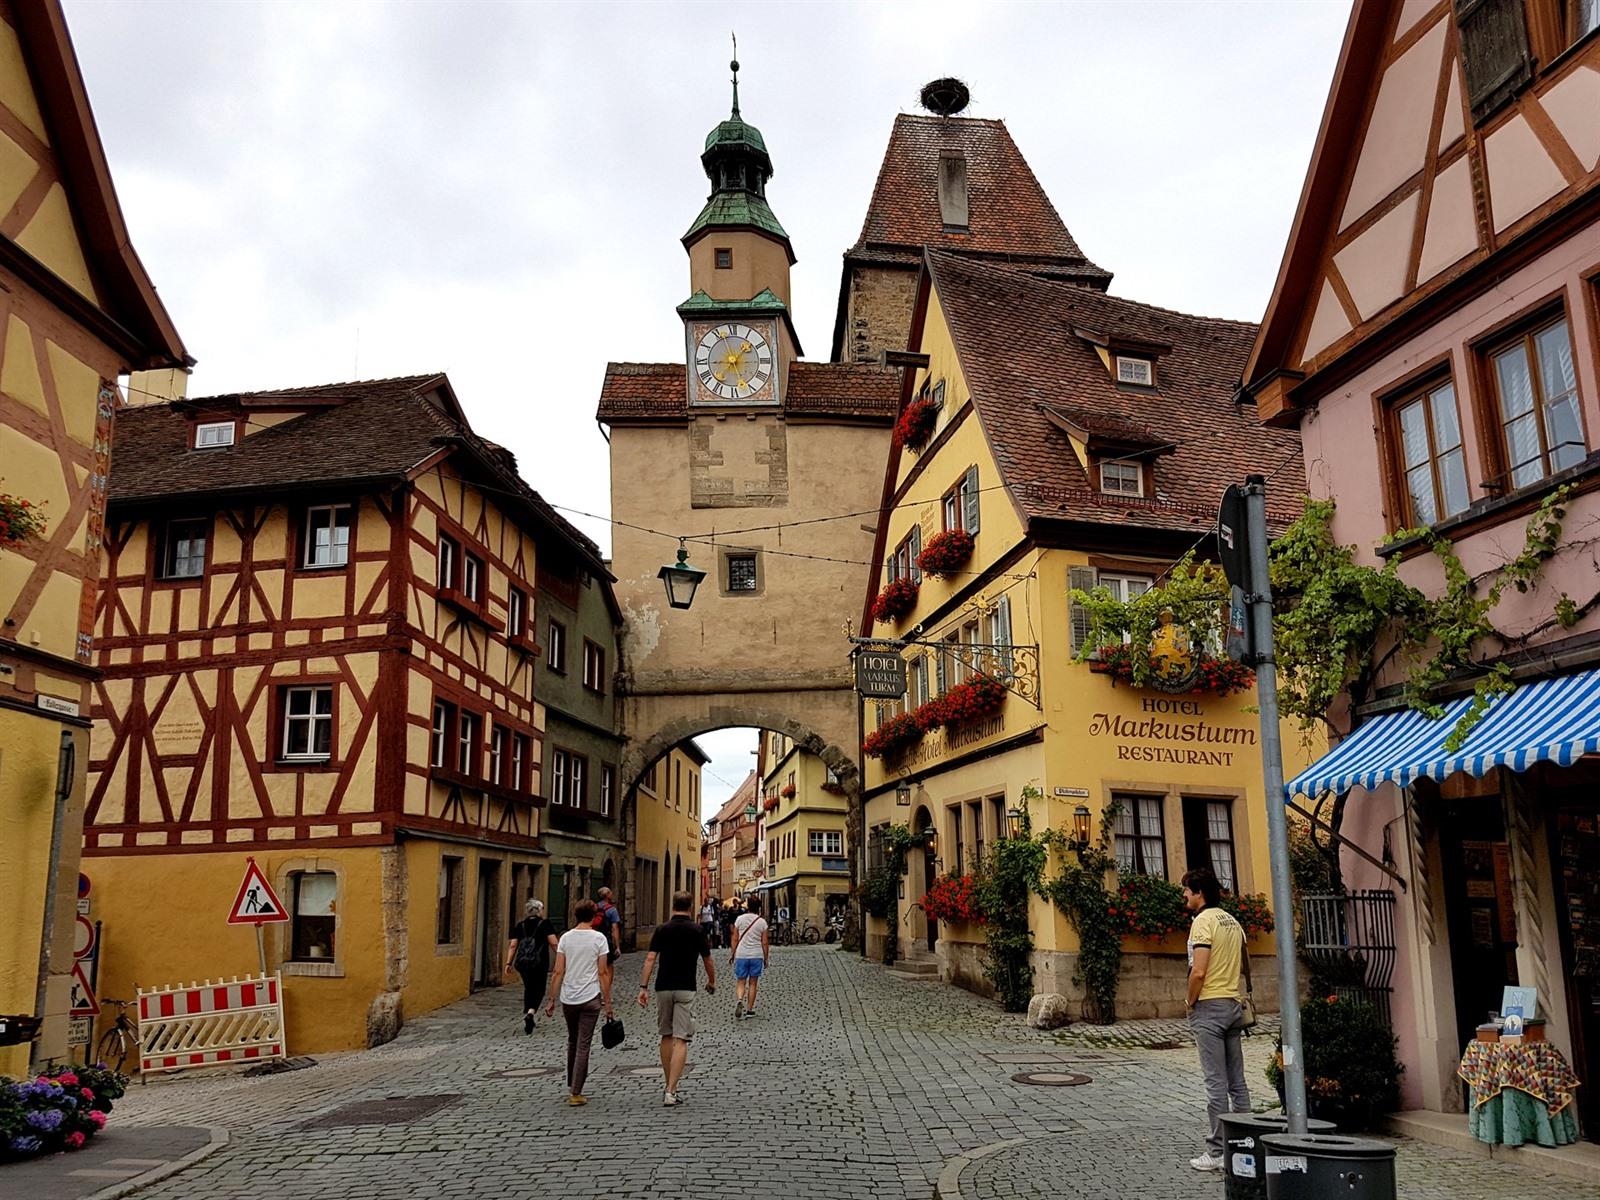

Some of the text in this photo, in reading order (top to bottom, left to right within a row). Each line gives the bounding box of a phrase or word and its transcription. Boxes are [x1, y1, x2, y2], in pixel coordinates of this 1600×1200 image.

[863, 657, 898, 671] HOTEL
[863, 672, 900, 683] MARKUS
[870, 682, 896, 693] TURM
[1142, 697, 1204, 716] HOTEL
[1088, 713, 1257, 746] Markusturm
[1117, 745, 1234, 767] RESTAURANT
